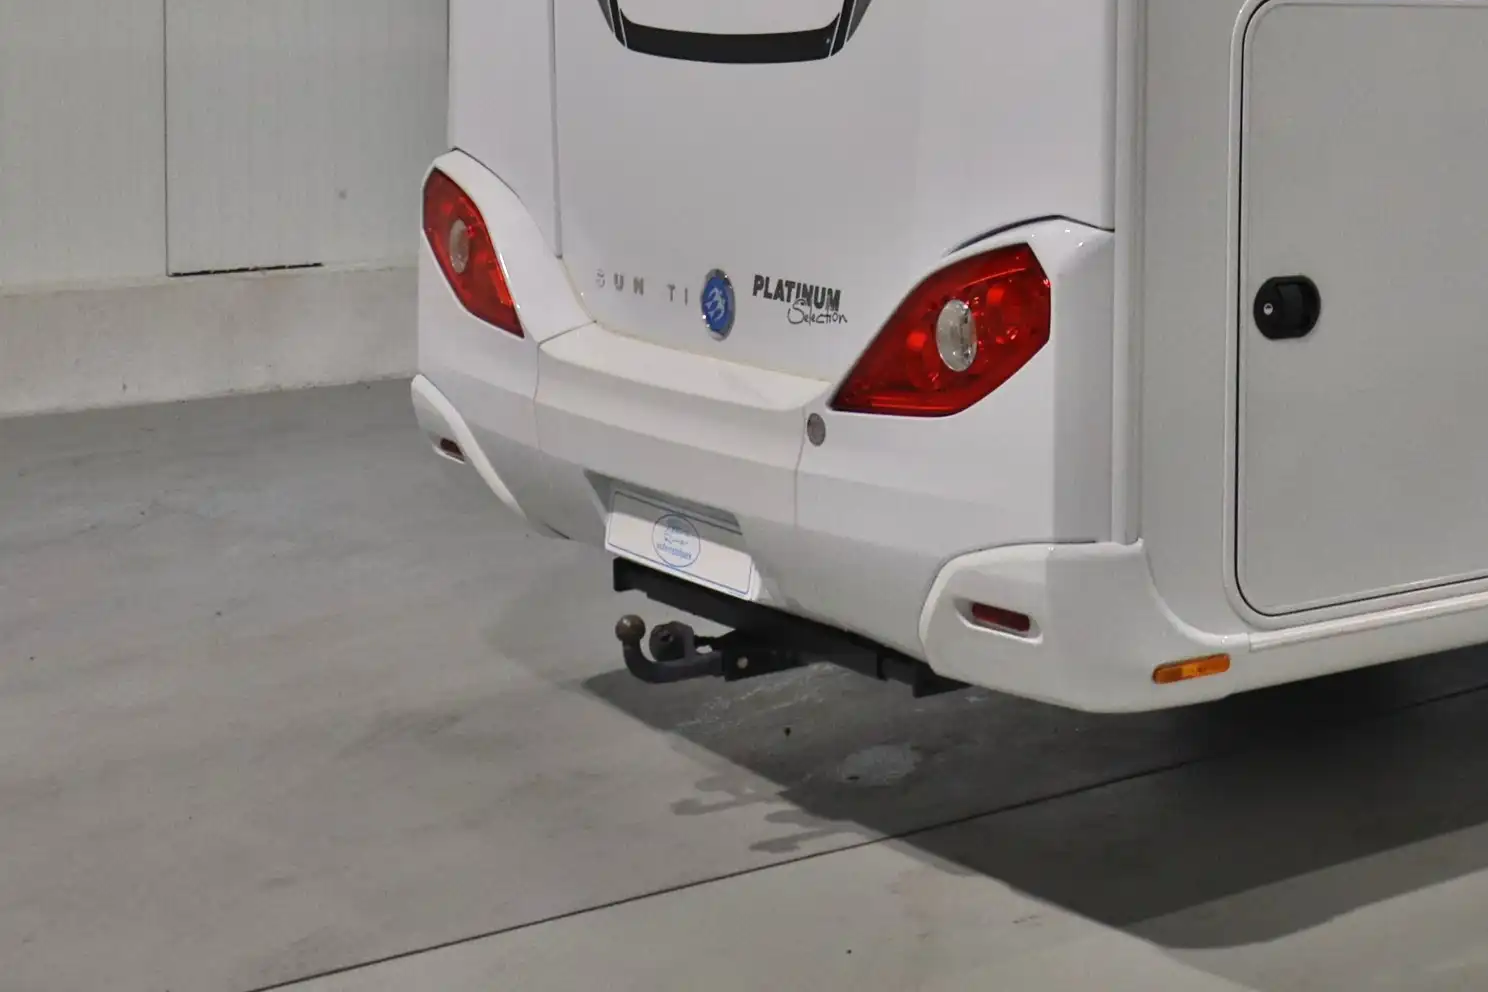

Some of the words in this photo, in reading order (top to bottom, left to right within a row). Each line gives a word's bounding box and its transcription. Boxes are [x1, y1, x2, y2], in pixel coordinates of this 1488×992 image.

[595, 268, 644, 296] SUN
[752, 273, 841, 312] PLATINUM
[786, 298, 848, 326] Selection
